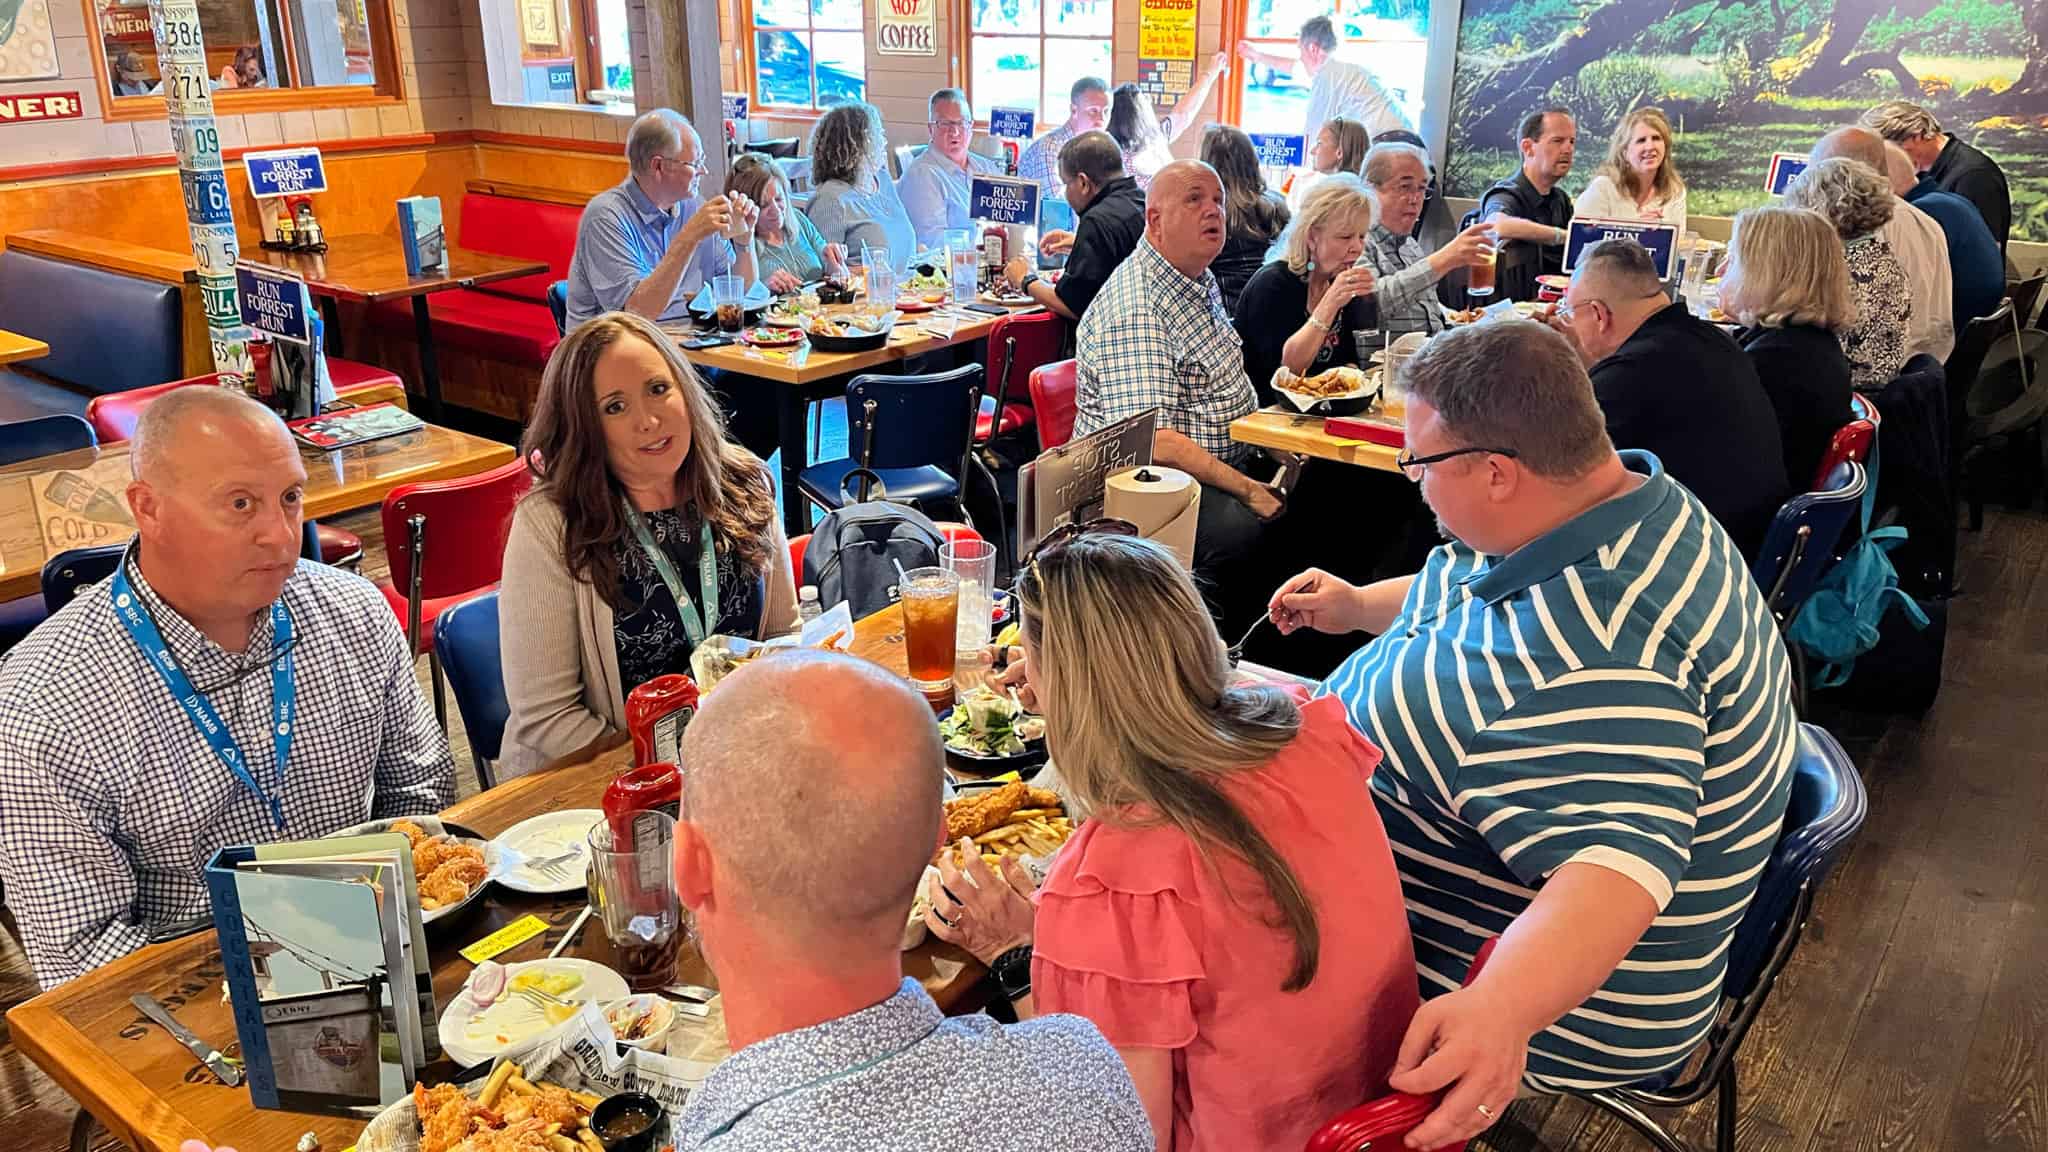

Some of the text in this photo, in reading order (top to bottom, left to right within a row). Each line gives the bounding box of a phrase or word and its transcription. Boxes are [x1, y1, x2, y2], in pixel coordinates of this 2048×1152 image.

[881, 24, 932, 49] COFFEE
[551, 72, 571, 84] EXIT
[272, 160, 299, 172] RUN
[261, 168, 313, 184] FORREST
[278, 179, 304, 192] RUN
[993, 186, 1016, 199] RUN
[980, 195, 1028, 212] FORREST
[991, 209, 1015, 222] RUN
[257, 280, 281, 299] RUN
[247, 293, 294, 319] FORREST
[260, 313, 285, 333] RUN
[124, 607, 144, 627] SBC
[280, 701, 289, 720] SBC
[194, 706, 218, 735] NAMB
